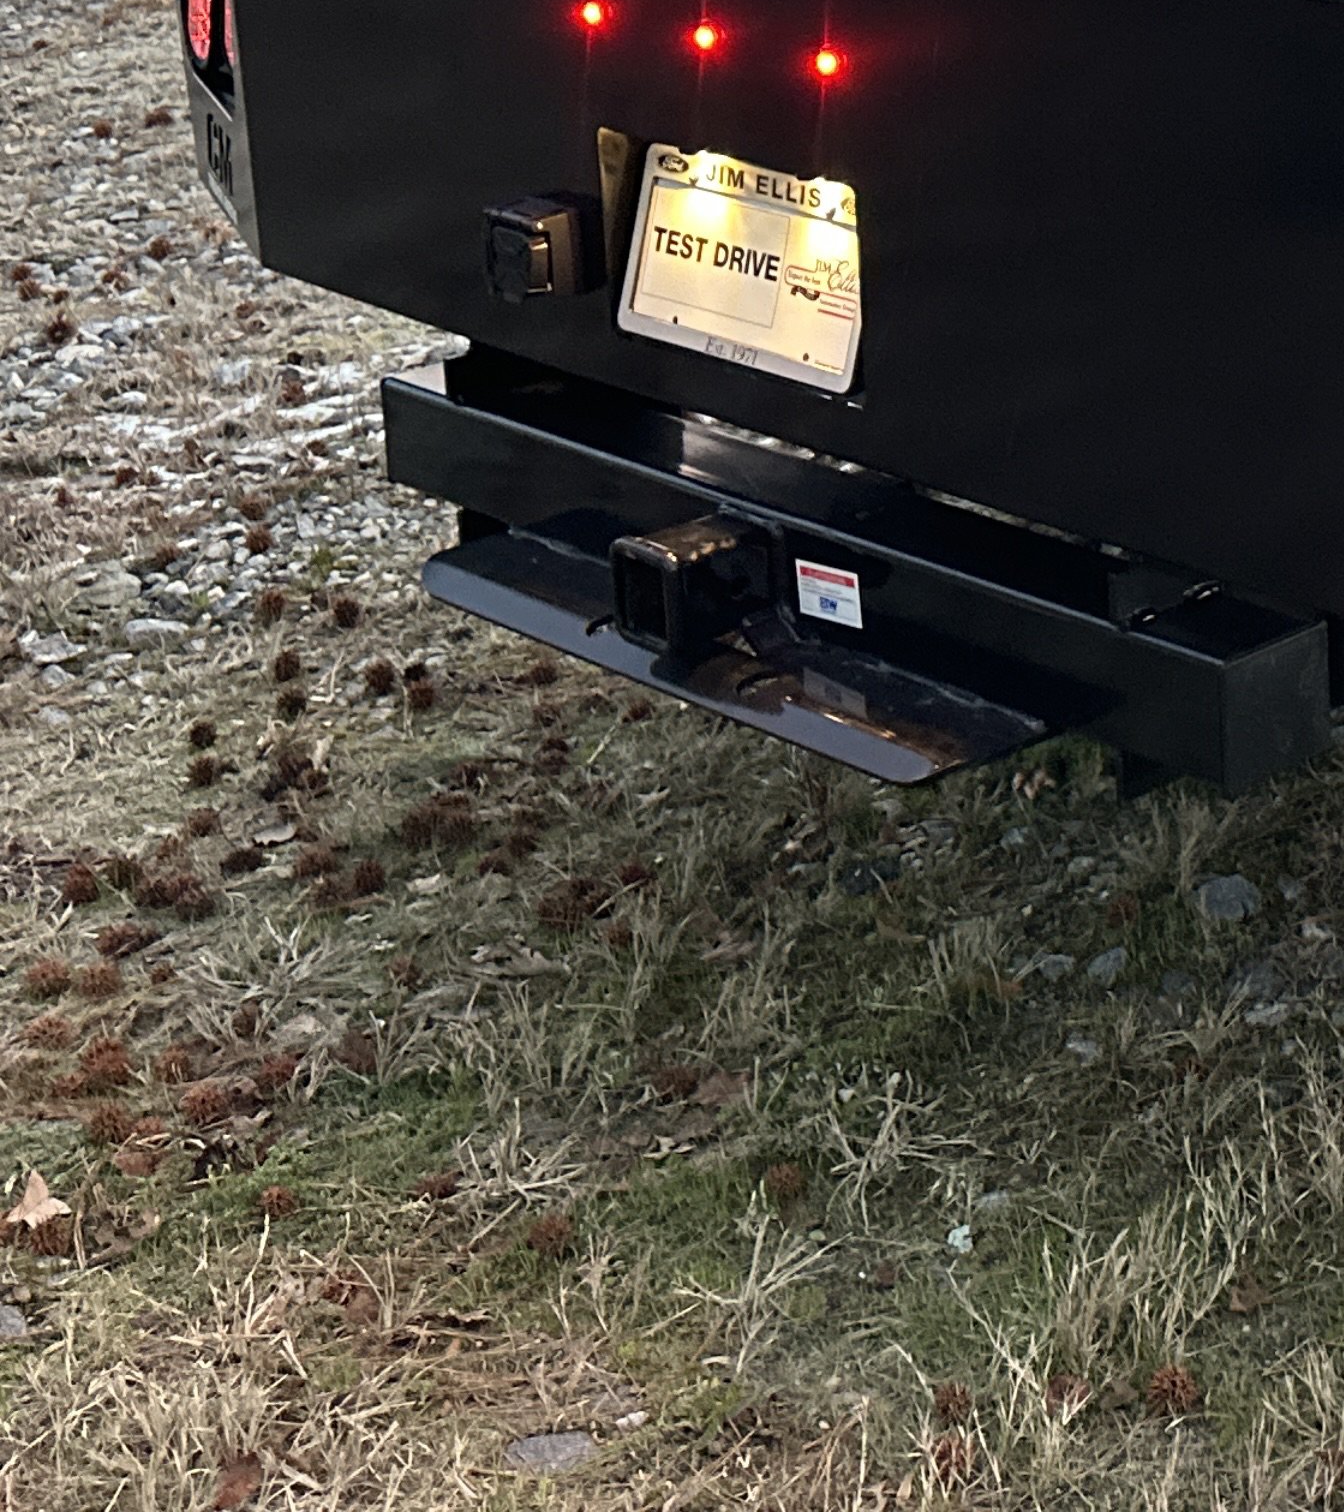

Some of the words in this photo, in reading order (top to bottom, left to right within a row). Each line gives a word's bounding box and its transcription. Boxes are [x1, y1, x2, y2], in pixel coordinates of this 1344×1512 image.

[706, 164, 745, 190] JIM
[756, 174, 821, 208] ELLIS
[653, 225, 709, 264] TEST
[713, 241, 782, 282] DRIVE
